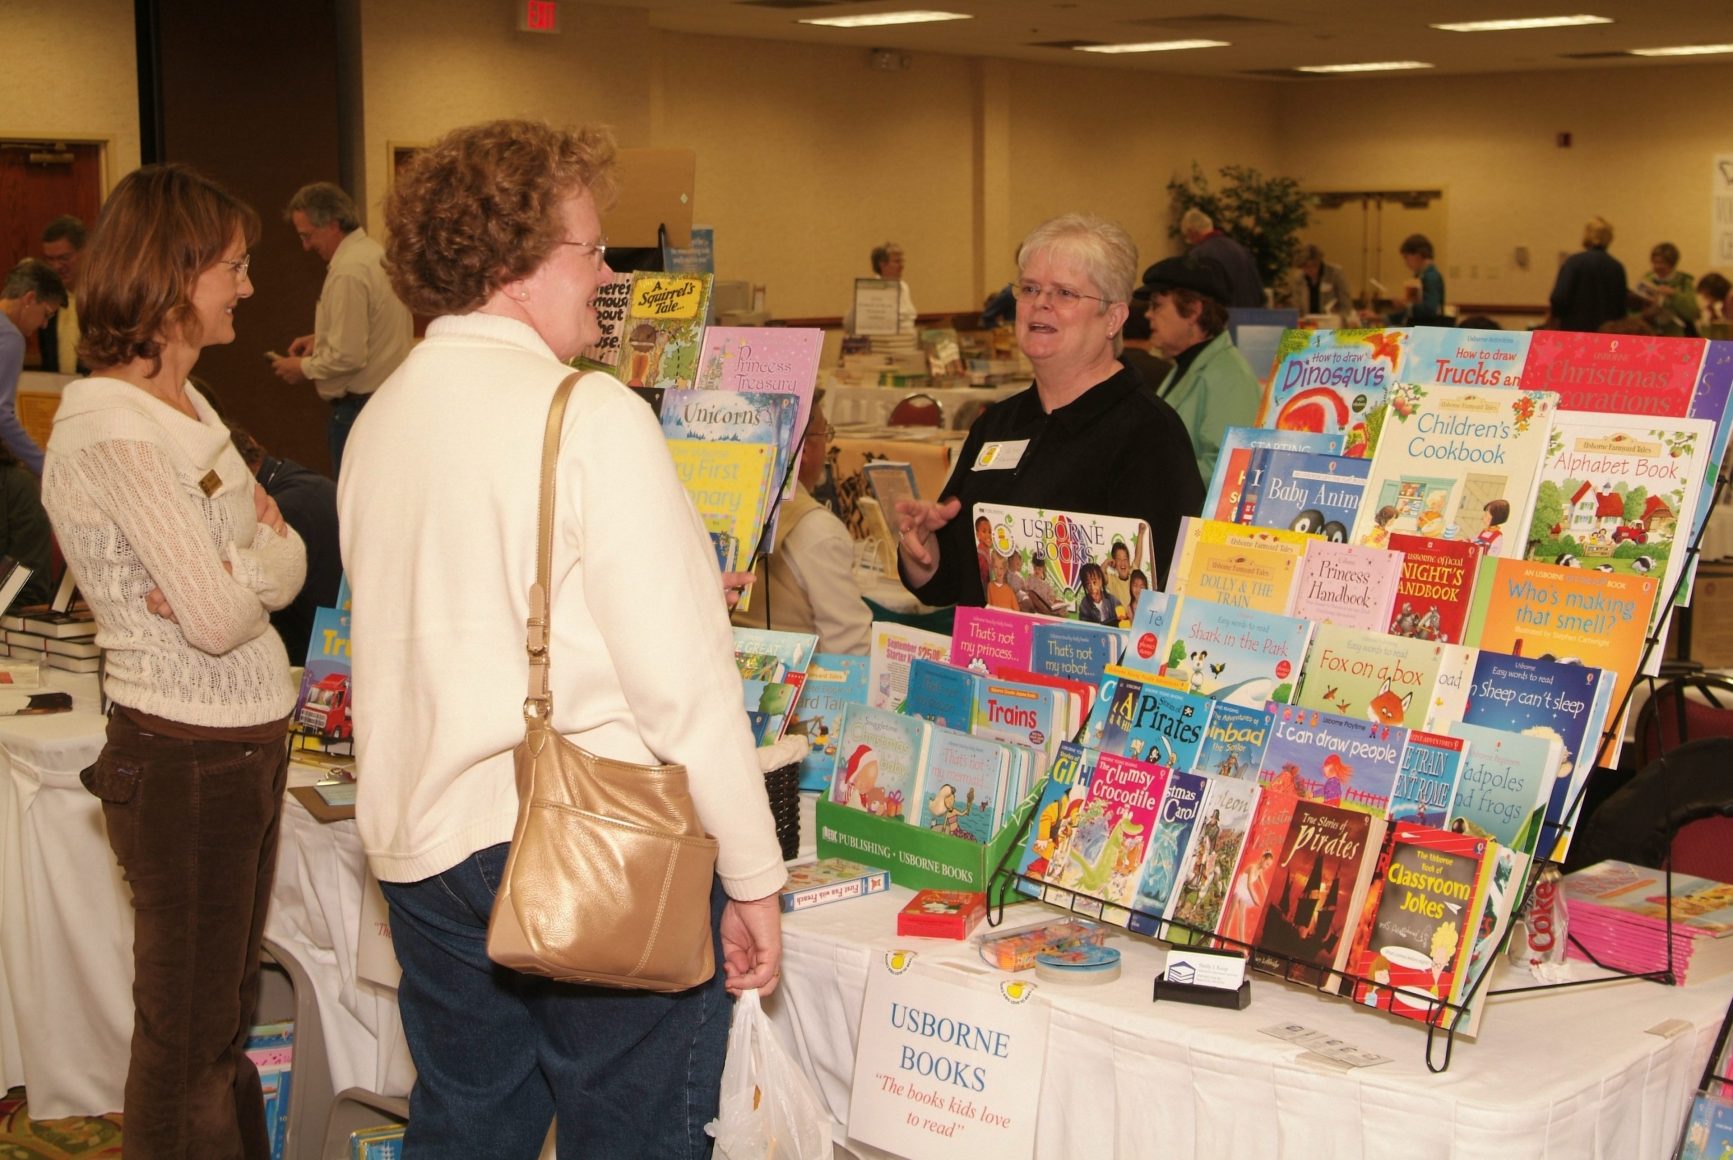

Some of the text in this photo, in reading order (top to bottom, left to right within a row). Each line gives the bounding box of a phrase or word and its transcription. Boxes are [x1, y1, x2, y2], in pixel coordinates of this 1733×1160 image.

[528, 1, 556, 30] EXIT
[638, 282, 696, 307] Squirrel's
[652, 281, 662, 292] A
[735, 345, 792, 373] Princess
[1312, 352, 1364, 363] How to draw
[1456, 347, 1517, 361] How to draw
[734, 374, 797, 392] Treasury
[1282, 359, 1385, 391] Dinosaurs
[1435, 359, 1521, 387] Trucks an
[1545, 360, 1671, 389] Christmas
[684, 402, 761, 426] Unicorns
[1416, 412, 1511, 439] Children's
[1408, 436, 1506, 464] Cookbook
[700, 461, 740, 480] First
[1553, 453, 1679, 480] Alphabet Book
[1268, 477, 1310, 509] Baby
[1313, 486, 1361, 510] Anim
[1022, 518, 1105, 546] USBORNE
[1035, 541, 1094, 564] BOOKS
[1200, 573, 1239, 591] DOLLY
[1251, 582, 1274, 598] THE
[1318, 560, 1370, 585] Princess
[1399, 564, 1464, 586] NIGHT'S
[1307, 580, 1371, 608] Handbook
[1397, 583, 1459, 602] ANDBOOK
[1508, 578, 1559, 605] Who's
[1565, 591, 1636, 621] making
[969, 622, 996, 641] That's
[997, 631, 1016, 646] not
[1516, 604, 1617, 637] that smell?
[960, 642, 976, 657] my
[1048, 640, 1093, 662] That's not
[1188, 623, 1289, 658] Shark in the Park
[1046, 660, 1060, 673] my
[1320, 649, 1424, 686] Fox on a box
[1439, 671, 1463, 689] oad
[1492, 665, 1555, 685] Easy words to read
[1479, 680, 1517, 706] Sheep
[1517, 686, 1553, 709] can't
[1553, 690, 1586, 714] sleep
[987, 699, 1037, 729] Trains
[1134, 695, 1202, 744] Pirates
[1208, 721, 1266, 747] inbad
[1276, 721, 1287, 738] I
[1286, 726, 1314, 744] can
[1316, 730, 1350, 753] draw
[1349, 741, 1397, 764] people
[1100, 761, 1110, 771] The
[1415, 749, 1449, 777] TRAIN
[1106, 766, 1155, 788] Clumsy
[1463, 763, 1524, 792] adpoles
[1092, 779, 1156, 810] Crocodile
[1416, 778, 1450, 809] ROME
[1456, 789, 1522, 824] nd frogs
[1163, 799, 1199, 823] Carol
[1302, 812, 1348, 833] True Stories of
[838, 827, 973, 884] PUBLISHING USBORNE BOOKS
[1417, 850, 1427, 860] The
[831, 887, 843, 898] Fun
[844, 883, 859, 895] First
[1388, 863, 1471, 900] Classroom
[797, 891, 818, 905] French
[1400, 891, 1445, 919] Jokes
[1528, 882, 1557, 953] Coke
[890, 1002, 1010, 1059] USBORNE
[900, 1045, 986, 1092] BOOKS
[907, 1083, 945, 1110] books
[948, 1096, 977, 1119] kids
[980, 1106, 1012, 1129] love
[907, 1112, 920, 1127] to
